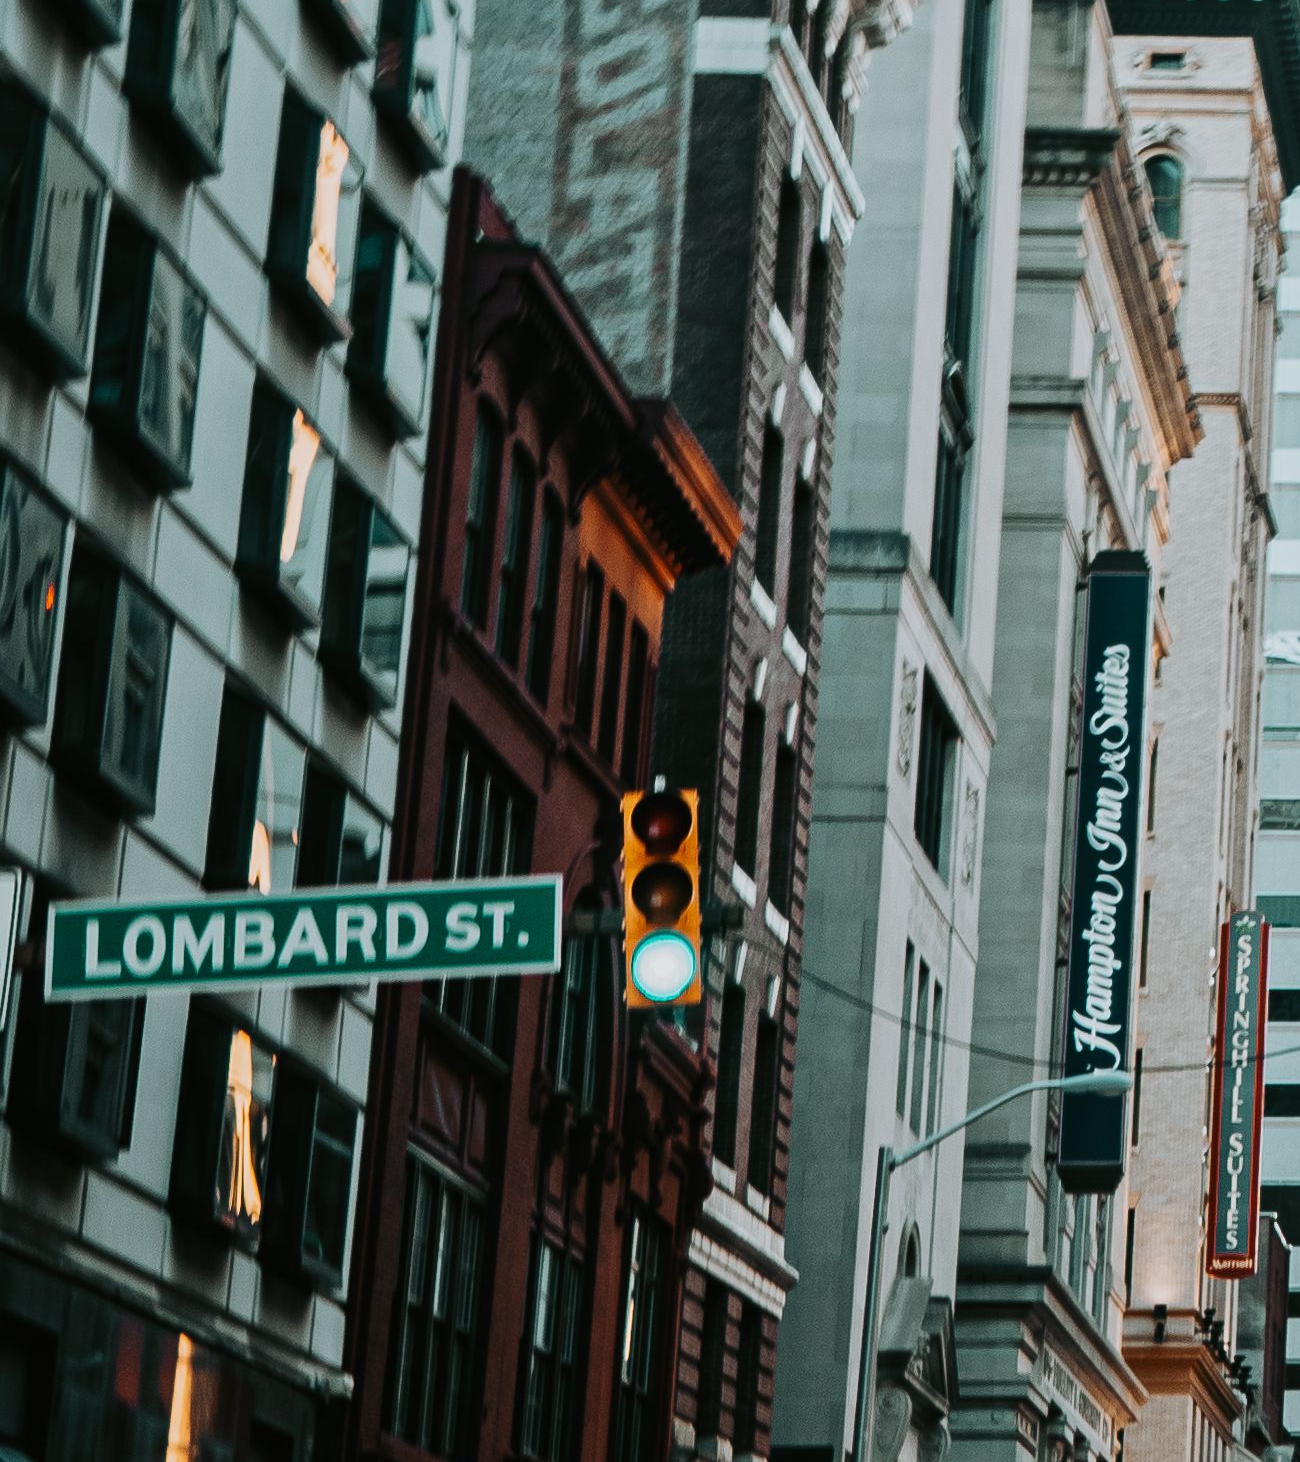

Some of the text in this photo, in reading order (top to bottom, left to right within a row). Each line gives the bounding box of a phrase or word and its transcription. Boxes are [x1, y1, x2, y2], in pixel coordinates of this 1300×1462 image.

[1089, 644, 1130, 750] Suites
[1087, 771, 1129, 872] Inn
[84, 900, 530, 979] LOMBARD ST.
[1073, 874, 1124, 1074] Hampton
[1230, 934, 1252, 1124] SPRINGHILL
[1226, 1132, 1244, 1251] SUITES
